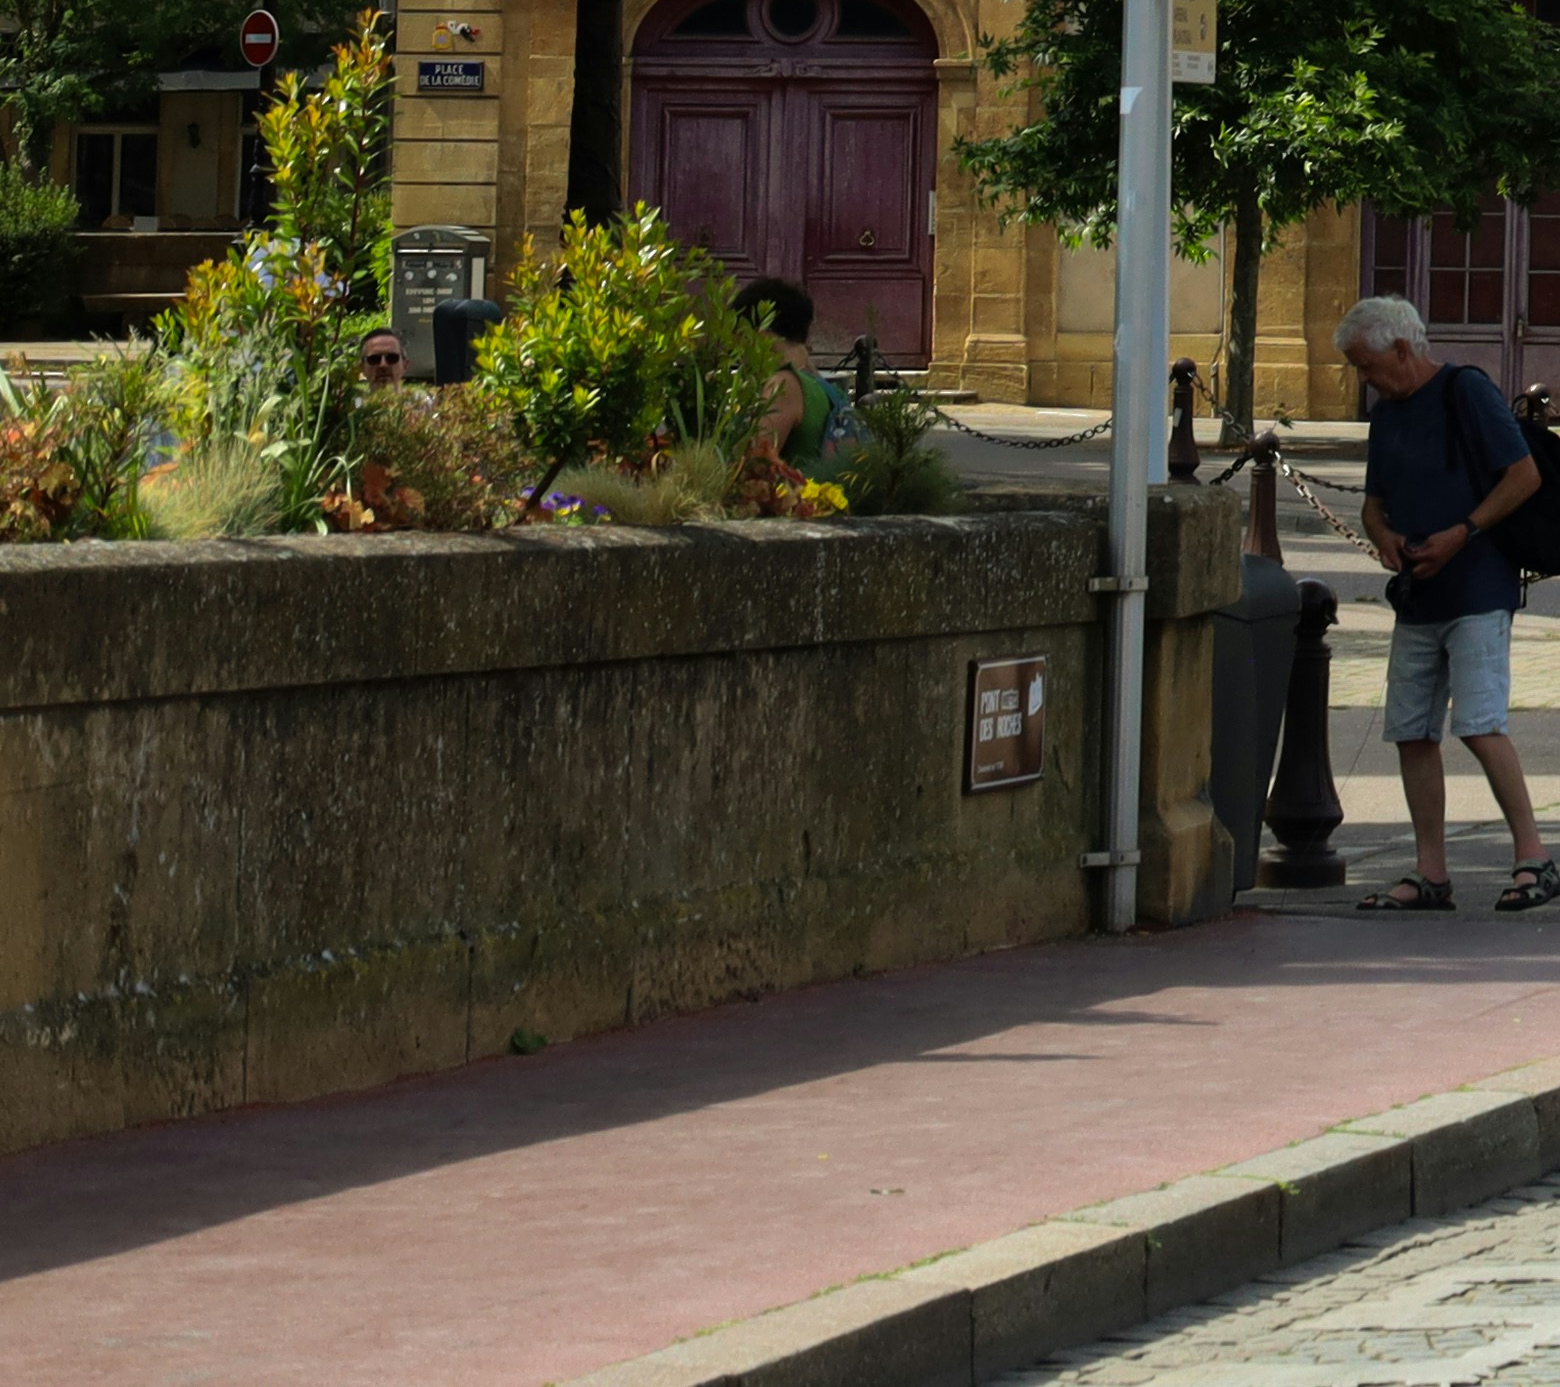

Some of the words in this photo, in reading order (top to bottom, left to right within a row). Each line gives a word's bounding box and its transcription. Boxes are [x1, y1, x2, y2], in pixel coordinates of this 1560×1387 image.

[435, 64, 463, 75] PLACE
[420, 74, 430, 86] DE
[431, 75, 441, 86] LA
